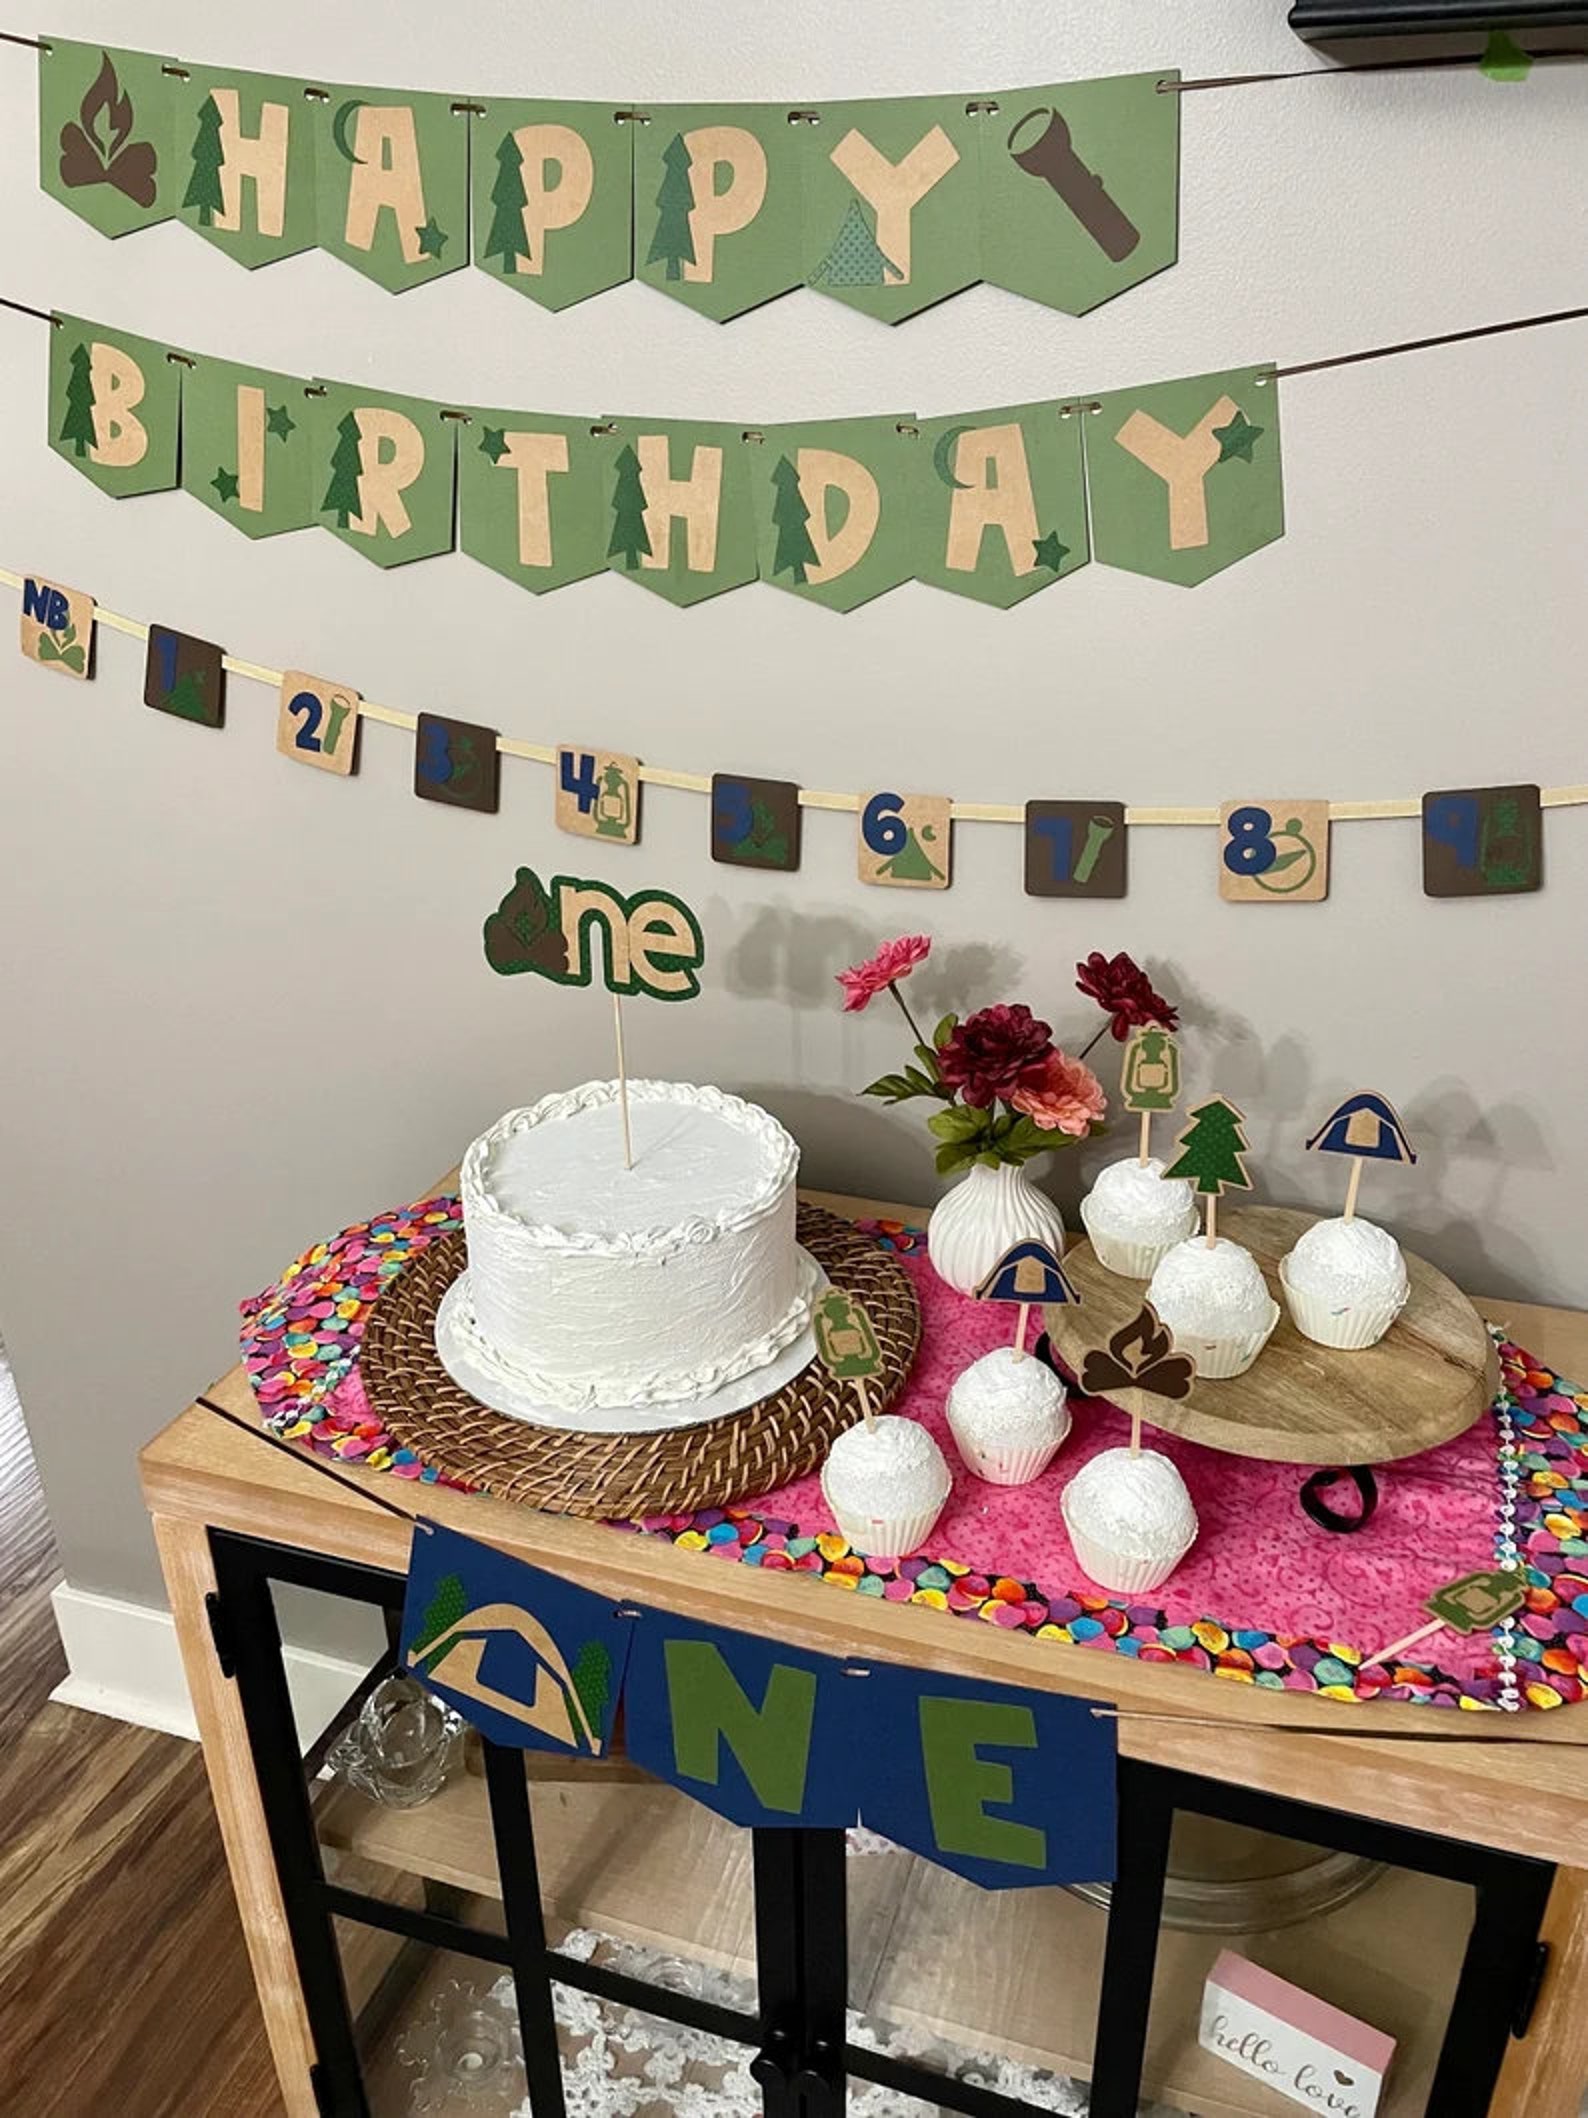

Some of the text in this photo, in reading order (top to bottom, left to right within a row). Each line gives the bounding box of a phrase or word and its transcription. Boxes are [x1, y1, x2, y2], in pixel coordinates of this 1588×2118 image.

[209, 88, 960, 286] HAPPY
[90, 342, 1250, 584] BIRTHDAY
[23, 578, 70, 630] NB
[156, 633, 178, 691] 1
[288, 691, 323, 752] 2
[418, 723, 454, 784] 3
[560, 751, 600, 814] 4
[862, 792, 907, 856] 6
[1035, 816, 1072, 881] 7
[1223, 806, 1277, 876] 8
[1210, 2015, 1361, 2118] hello love
